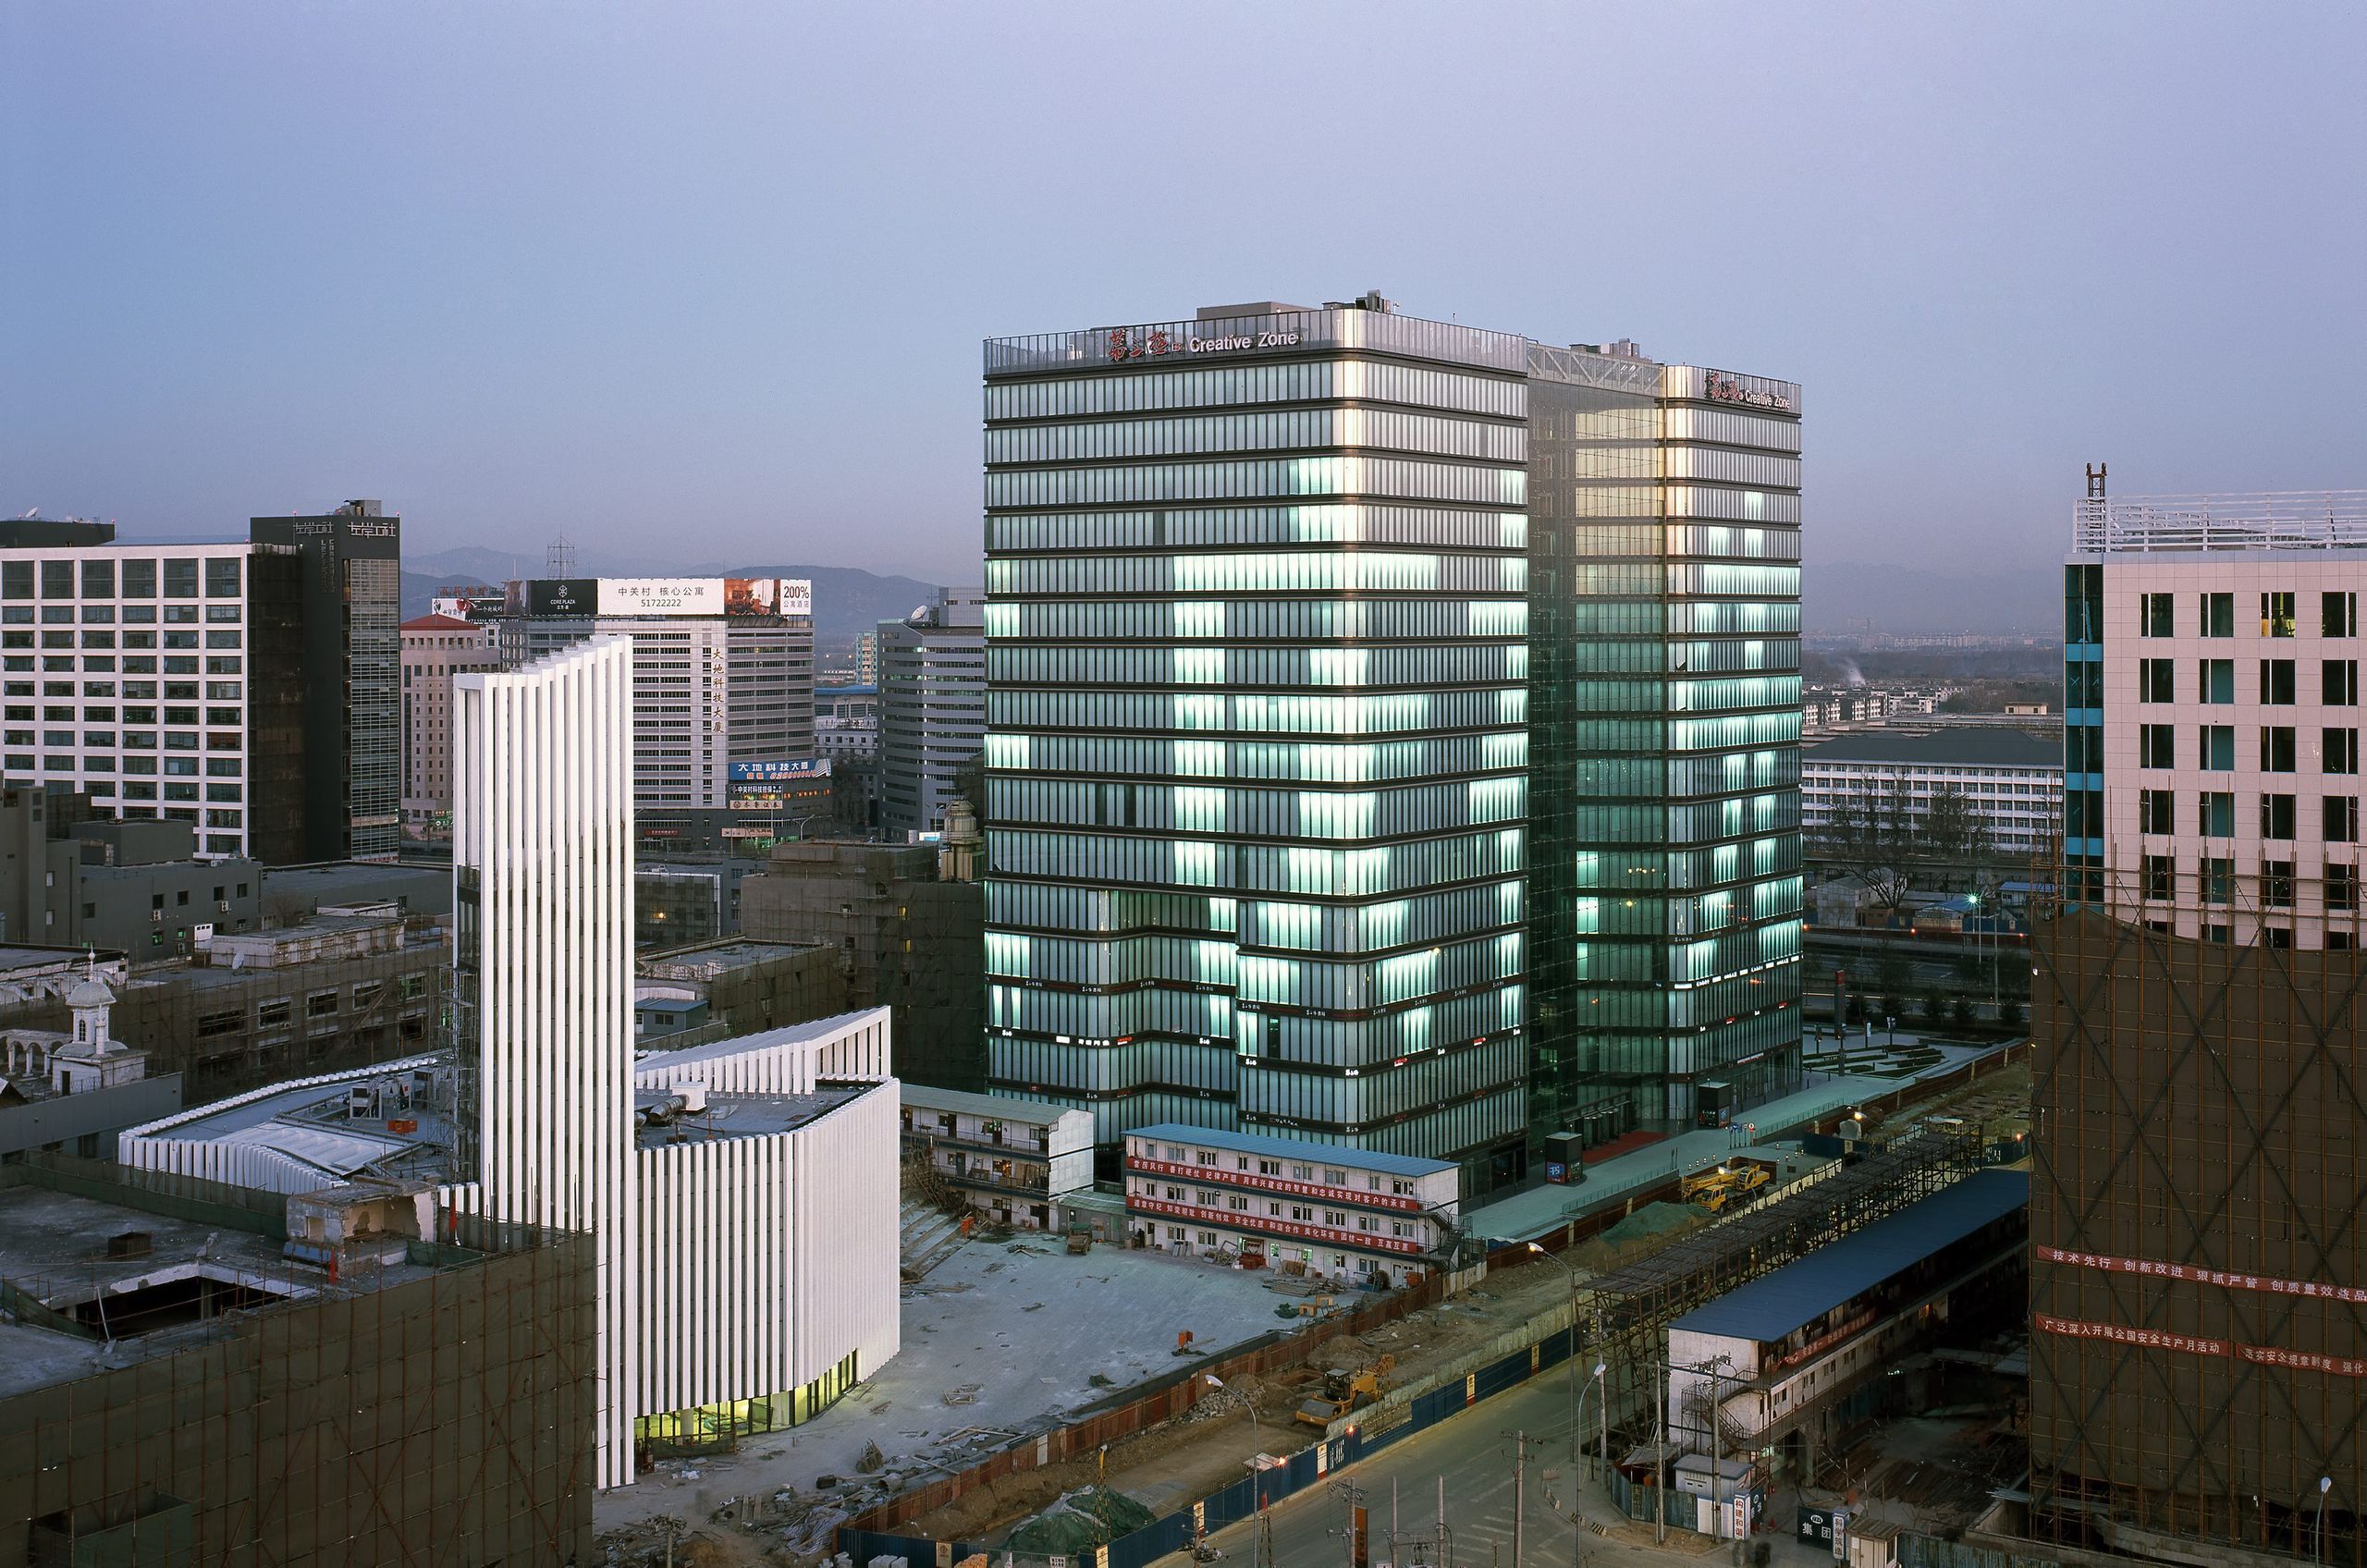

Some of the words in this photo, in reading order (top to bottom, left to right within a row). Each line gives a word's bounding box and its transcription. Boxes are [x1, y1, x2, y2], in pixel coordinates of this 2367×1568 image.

[1189, 334, 1251, 353] Creative
[1257, 331, 1298, 348] Zone
[1745, 389, 1772, 407] Creative
[1774, 395, 1791, 409] Zone
[618, 587, 651, 596] 中关村
[659, 586, 705, 596] 核心公寓
[783, 585, 810, 599] 200%
[641, 599, 681, 607] 51722222
[783, 600, 810, 608] 公寓酒店
[712, 648, 725, 733] 大地科技大厦
[2053, 1250, 2112, 1268] 技术先行
[2123, 1260, 2183, 1278] 创新改进
[2196, 1269, 2258, 1289] 狠抓严管
[2045, 1319, 2220, 1354] 广泛深入开展全国安全生产月活动
